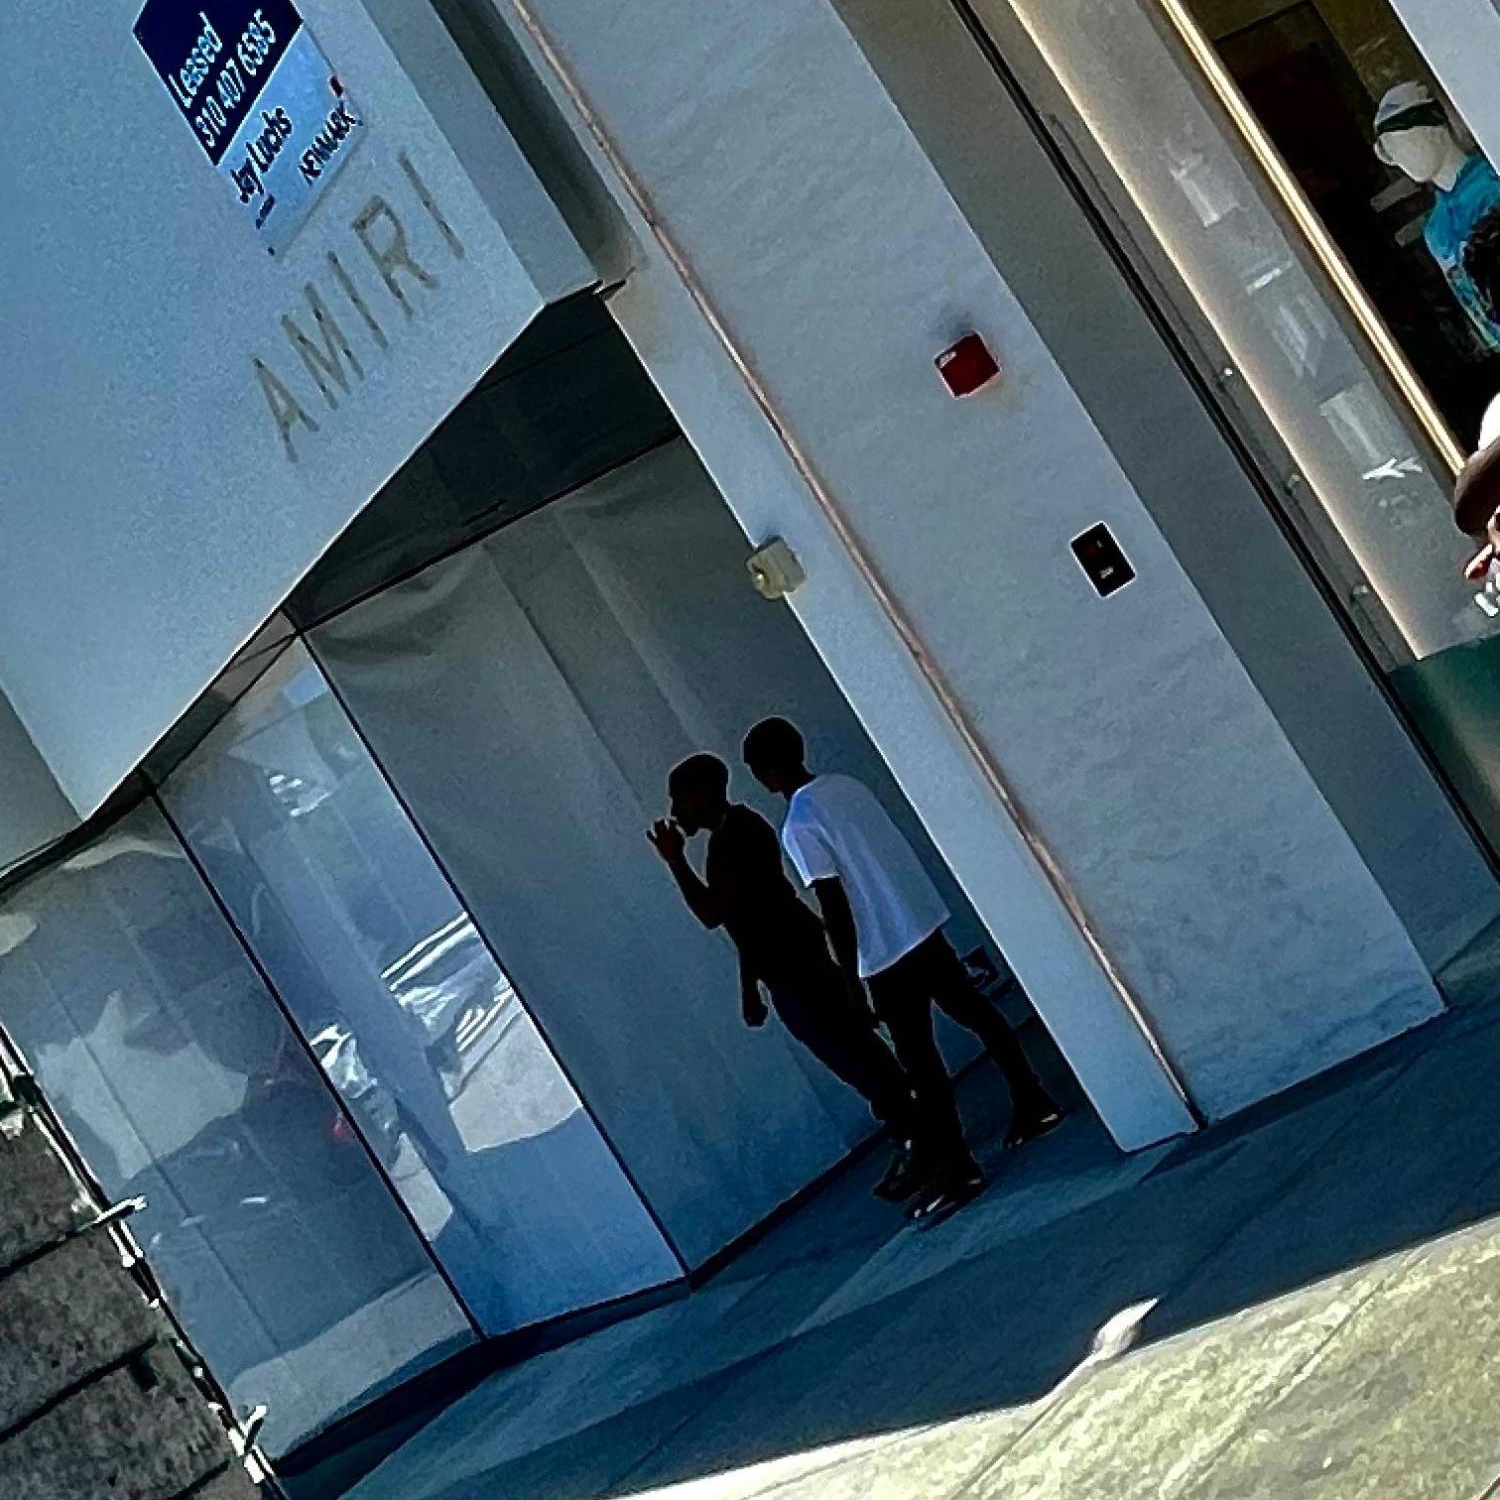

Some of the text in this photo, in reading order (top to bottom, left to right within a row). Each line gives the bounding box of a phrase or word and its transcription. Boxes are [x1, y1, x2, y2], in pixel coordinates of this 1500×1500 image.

[168, 11, 222, 108] Leased
[195, 95, 227, 148] 310
[216, 58, 246, 109] 407
[251, 150, 465, 463] AMIRI
